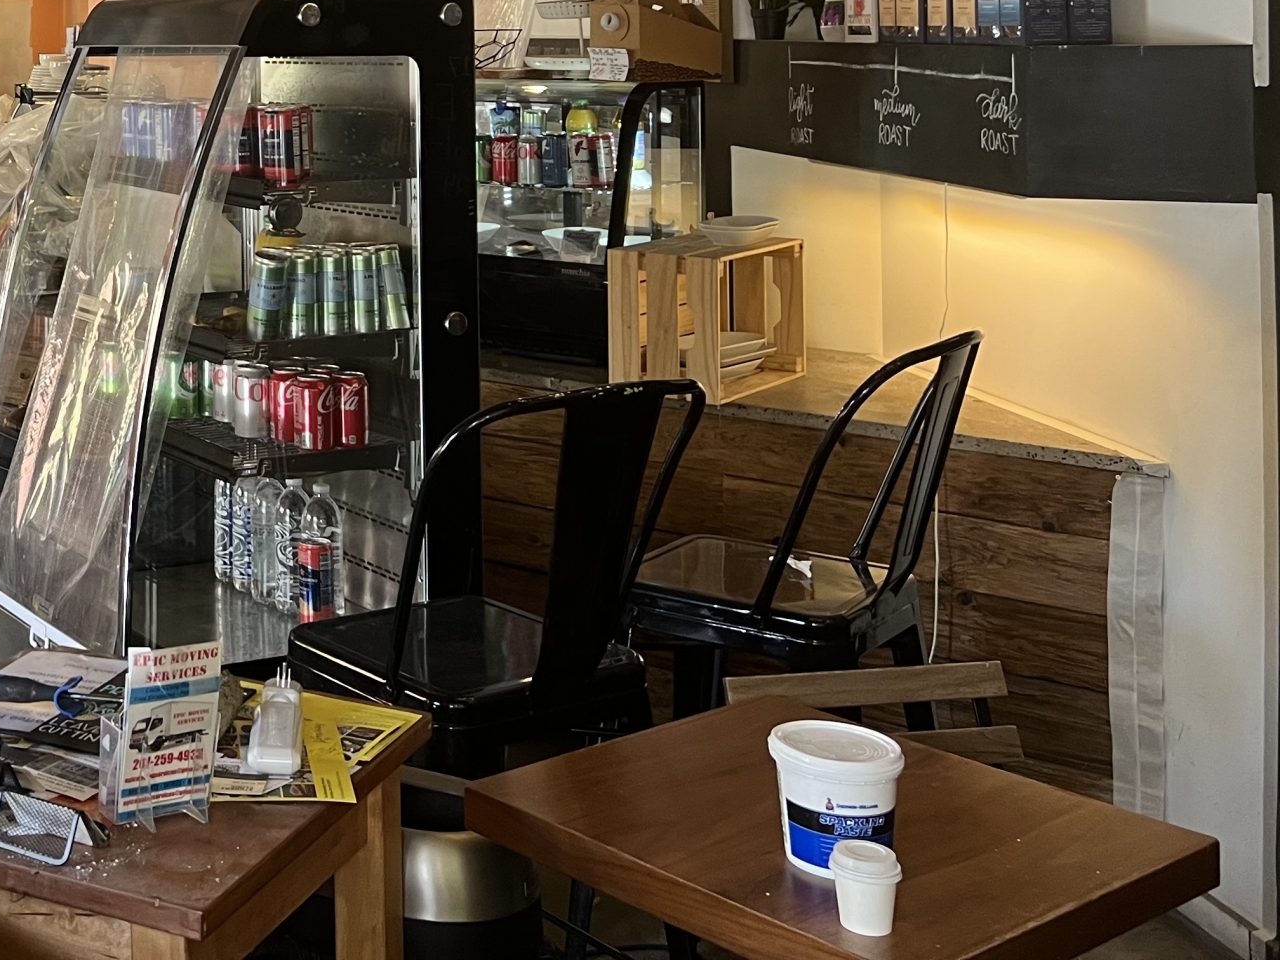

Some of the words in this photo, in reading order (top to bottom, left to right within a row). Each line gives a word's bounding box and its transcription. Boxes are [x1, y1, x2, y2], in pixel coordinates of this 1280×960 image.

[788, 84, 815, 123] light
[873, 85, 921, 126] medium
[976, 88, 1022, 130] dark
[878, 123, 912, 147] ROAST
[980, 128, 1019, 155] ROAST
[133, 654, 167, 668] EPIC
[170, 647, 219, 665] MOVING
[145, 665, 208, 684] SERVICES
[819, 814, 885, 828] SPACKLING
[833, 824, 873, 837] PASTE
